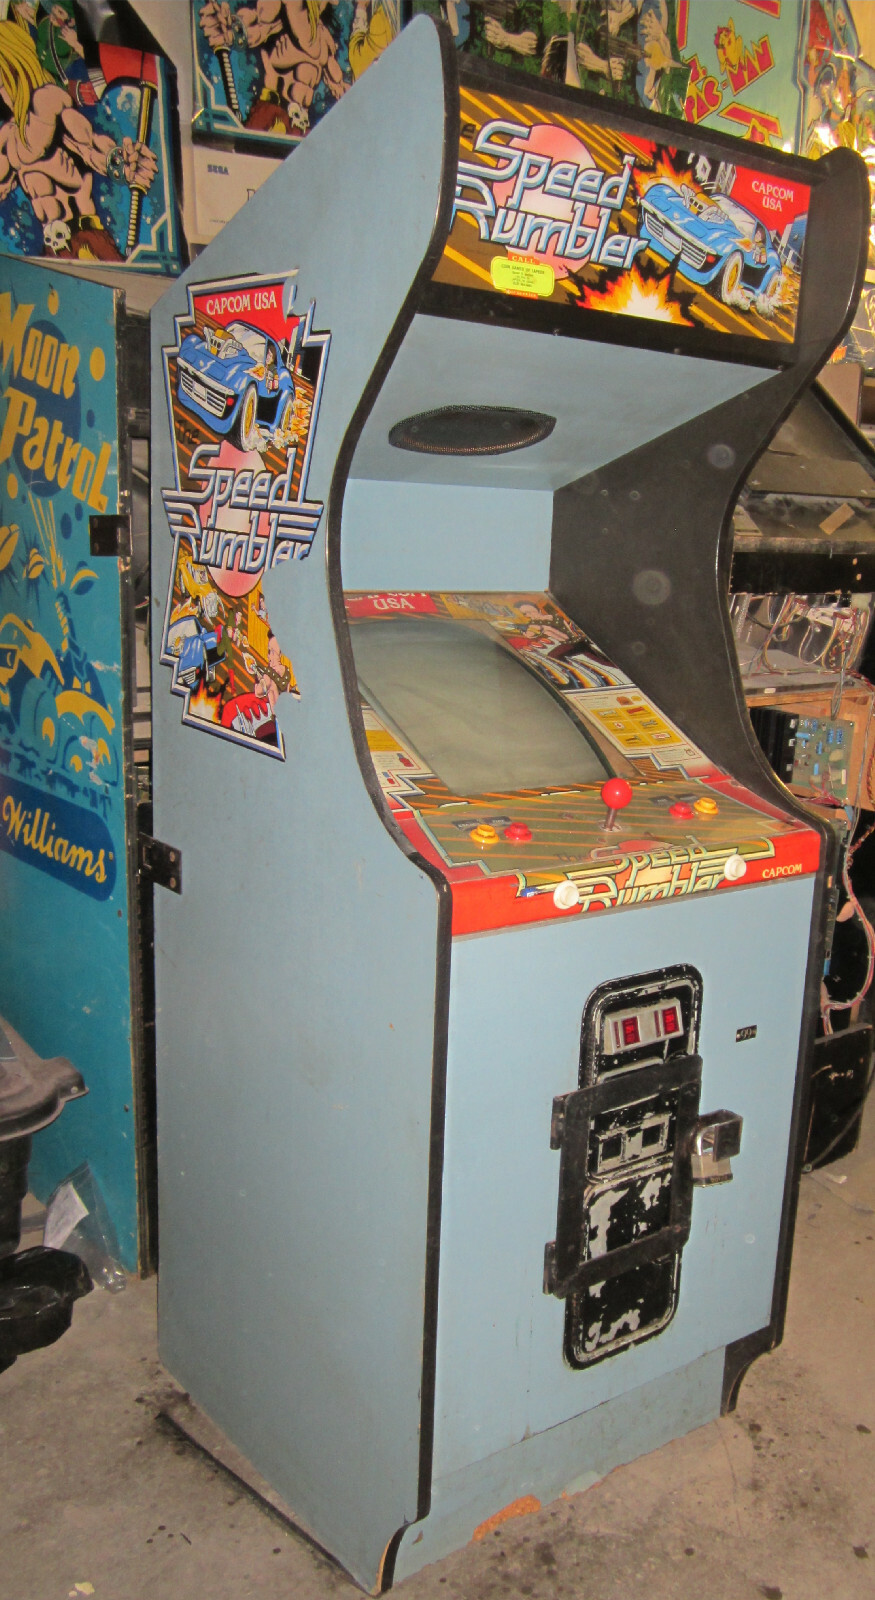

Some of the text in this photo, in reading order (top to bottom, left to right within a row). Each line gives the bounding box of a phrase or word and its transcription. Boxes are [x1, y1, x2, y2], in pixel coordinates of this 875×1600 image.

[207, 164, 229, 175] SEGA
[457, 118, 637, 211] Speed
[752, 180, 794, 203] CAPCOM
[762, 195, 782, 212] USA
[450, 173, 651, 269] Rumbler
[206, 290, 278, 316] CAPCOM USA
[163, 445, 321, 530] Speed
[164, 500, 316, 574] Rumbler
[373, 597, 415, 610] USA
[762, 863, 802, 879] CAPCOM
